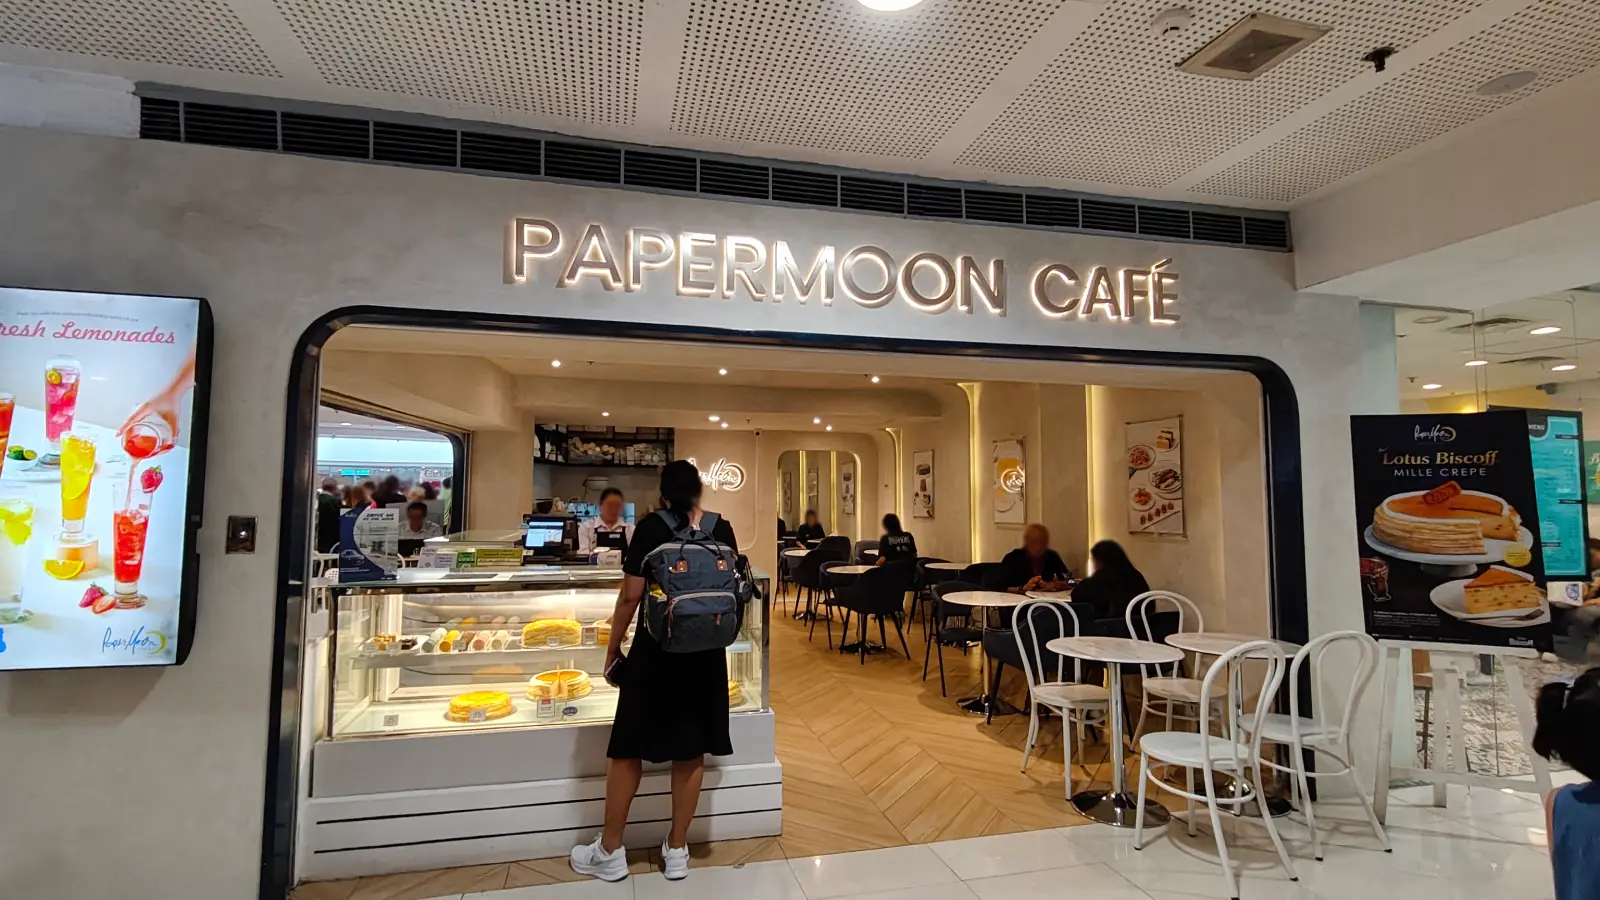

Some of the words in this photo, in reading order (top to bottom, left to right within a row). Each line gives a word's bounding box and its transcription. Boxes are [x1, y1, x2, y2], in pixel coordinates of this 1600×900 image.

[513, 217, 1005, 314] PAPERMOON
[1032, 257, 1180, 324] CAFÉ
[53, 321, 175, 344] Lemonades
[1383, 453, 1430, 465] Lotus
[1436, 450, 1499, 466] Biscoff
[1394, 468, 1433, 477] MILLE
[1439, 468, 1487, 477] CREPE
